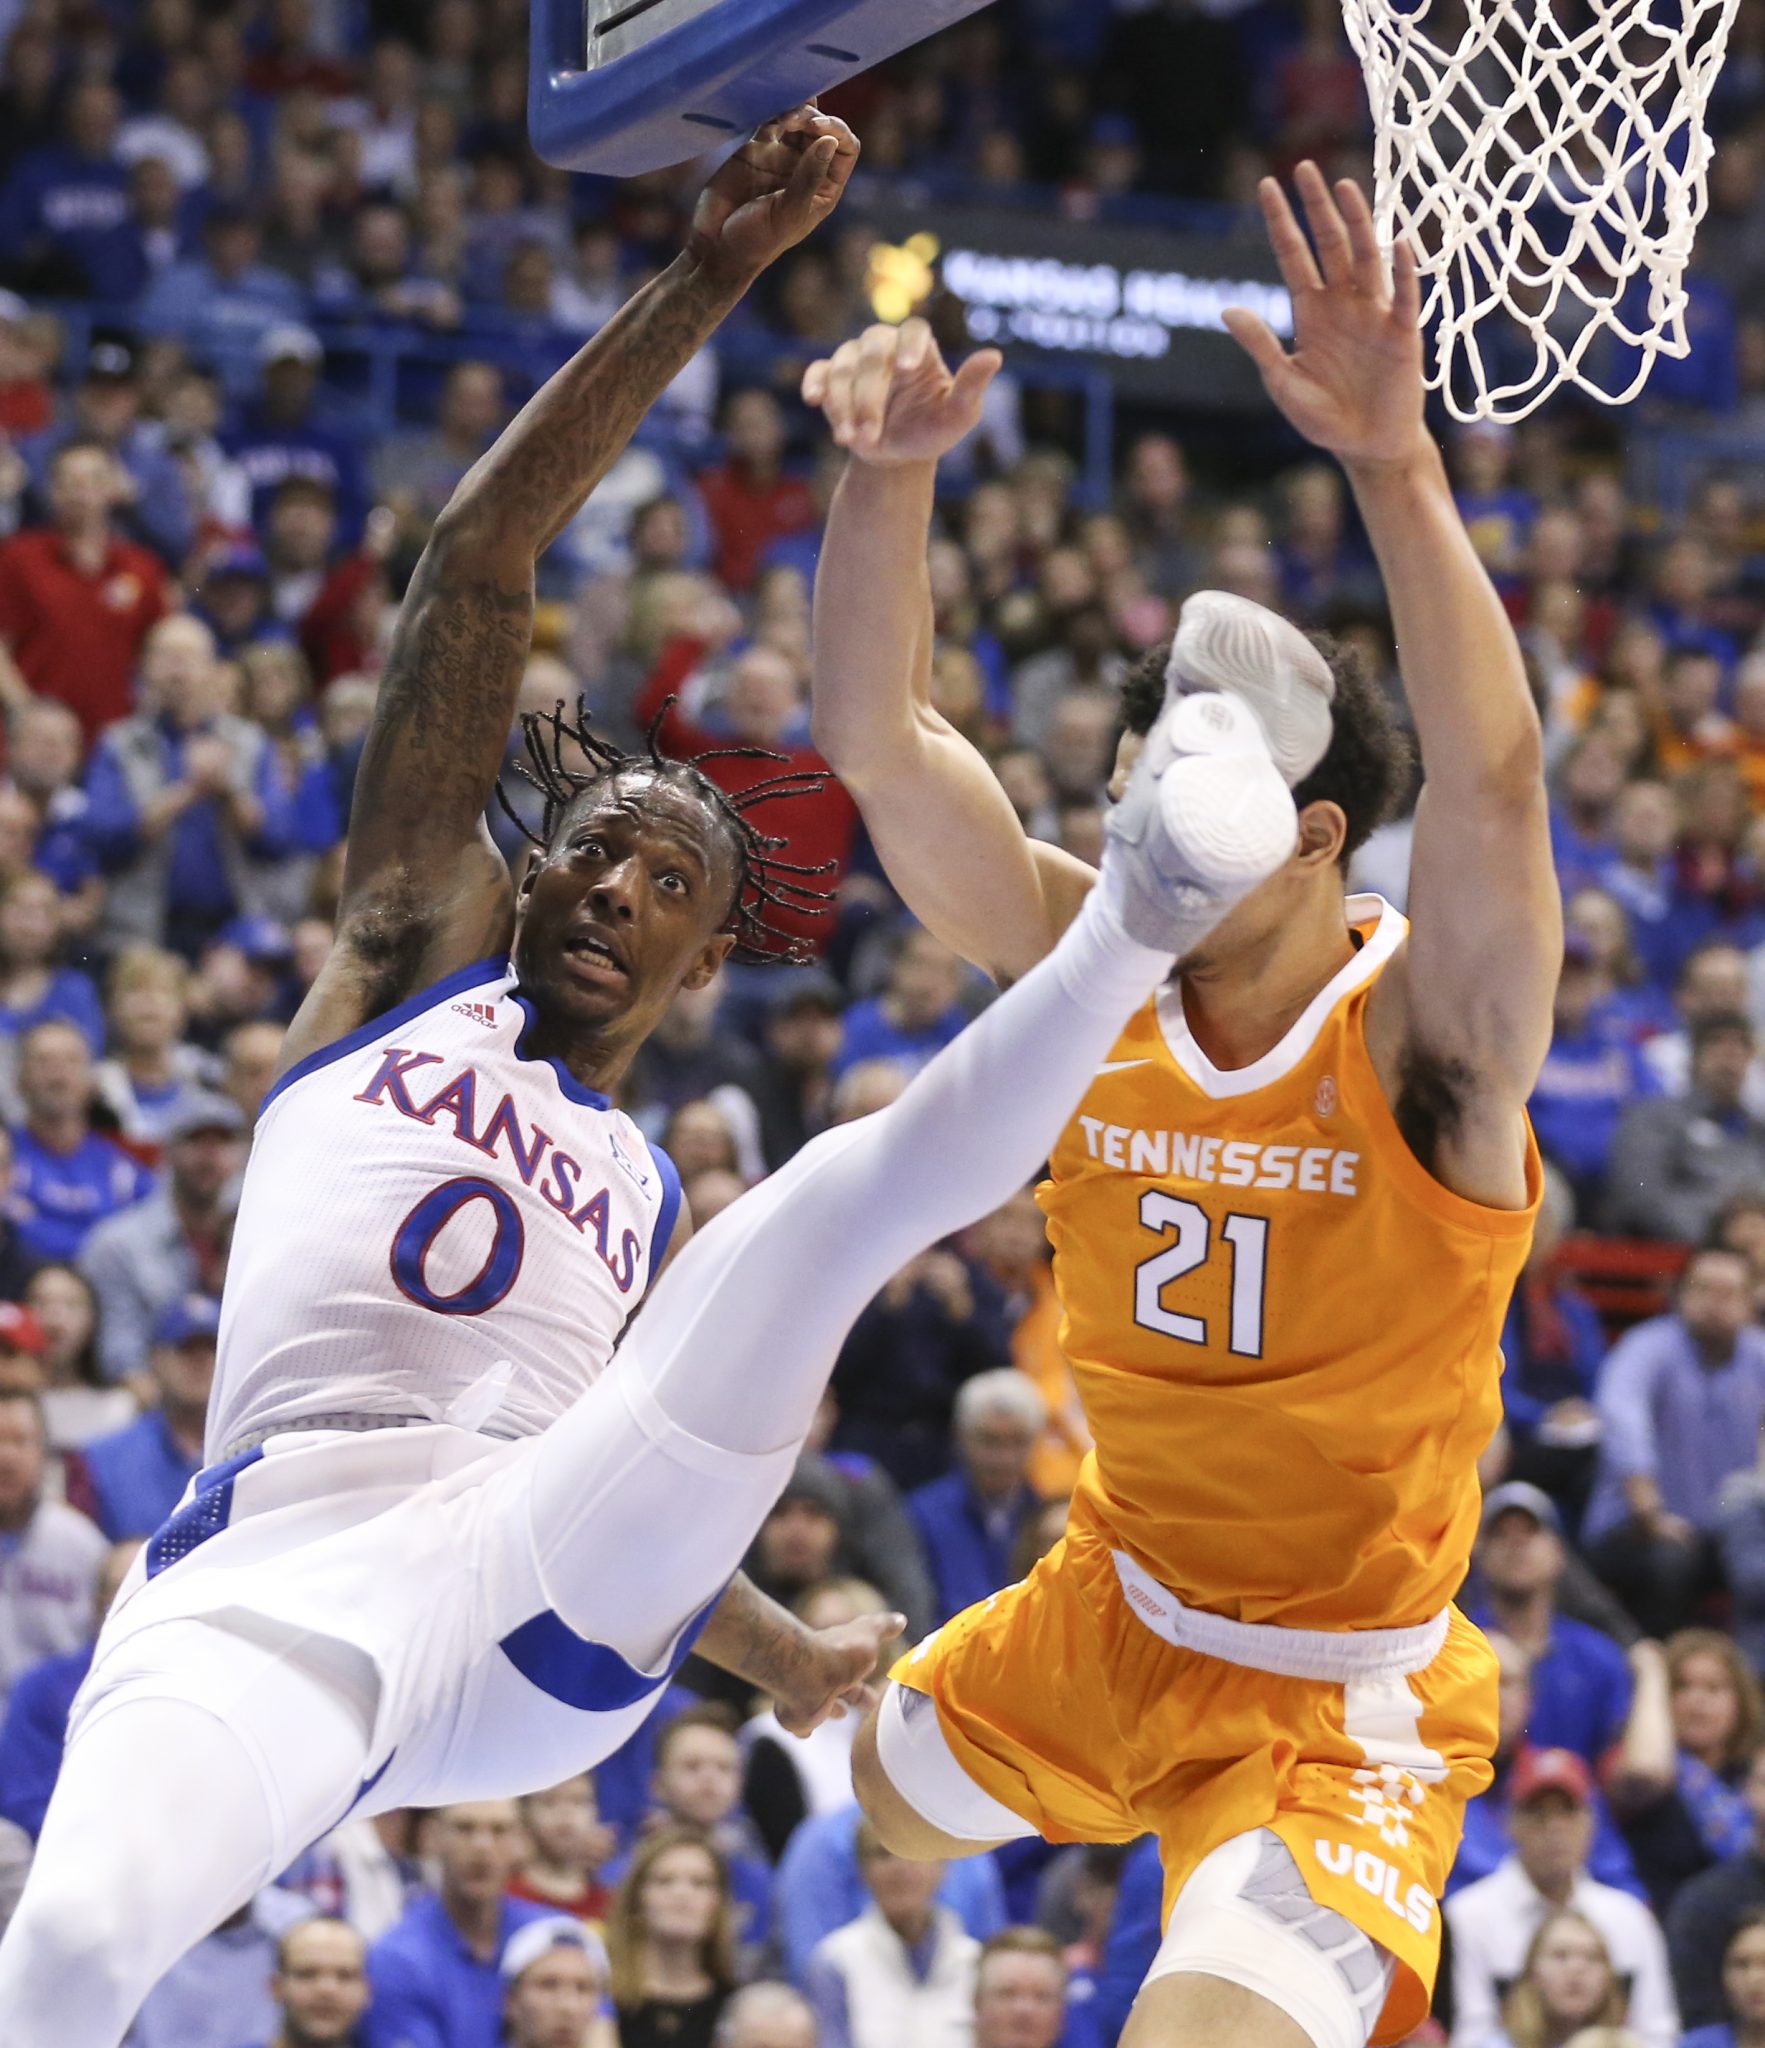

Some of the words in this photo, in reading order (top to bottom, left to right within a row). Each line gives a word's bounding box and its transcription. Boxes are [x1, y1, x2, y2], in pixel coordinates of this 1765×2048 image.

[451, 1003, 499, 1029] adidas
[353, 1048, 642, 1293] KANSAS
[1078, 1114, 1360, 1197] TENNESSEE
[390, 1175, 525, 1316] 0
[1132, 1187, 1271, 1360] 21
[1314, 1838, 1435, 1934] VOLS
